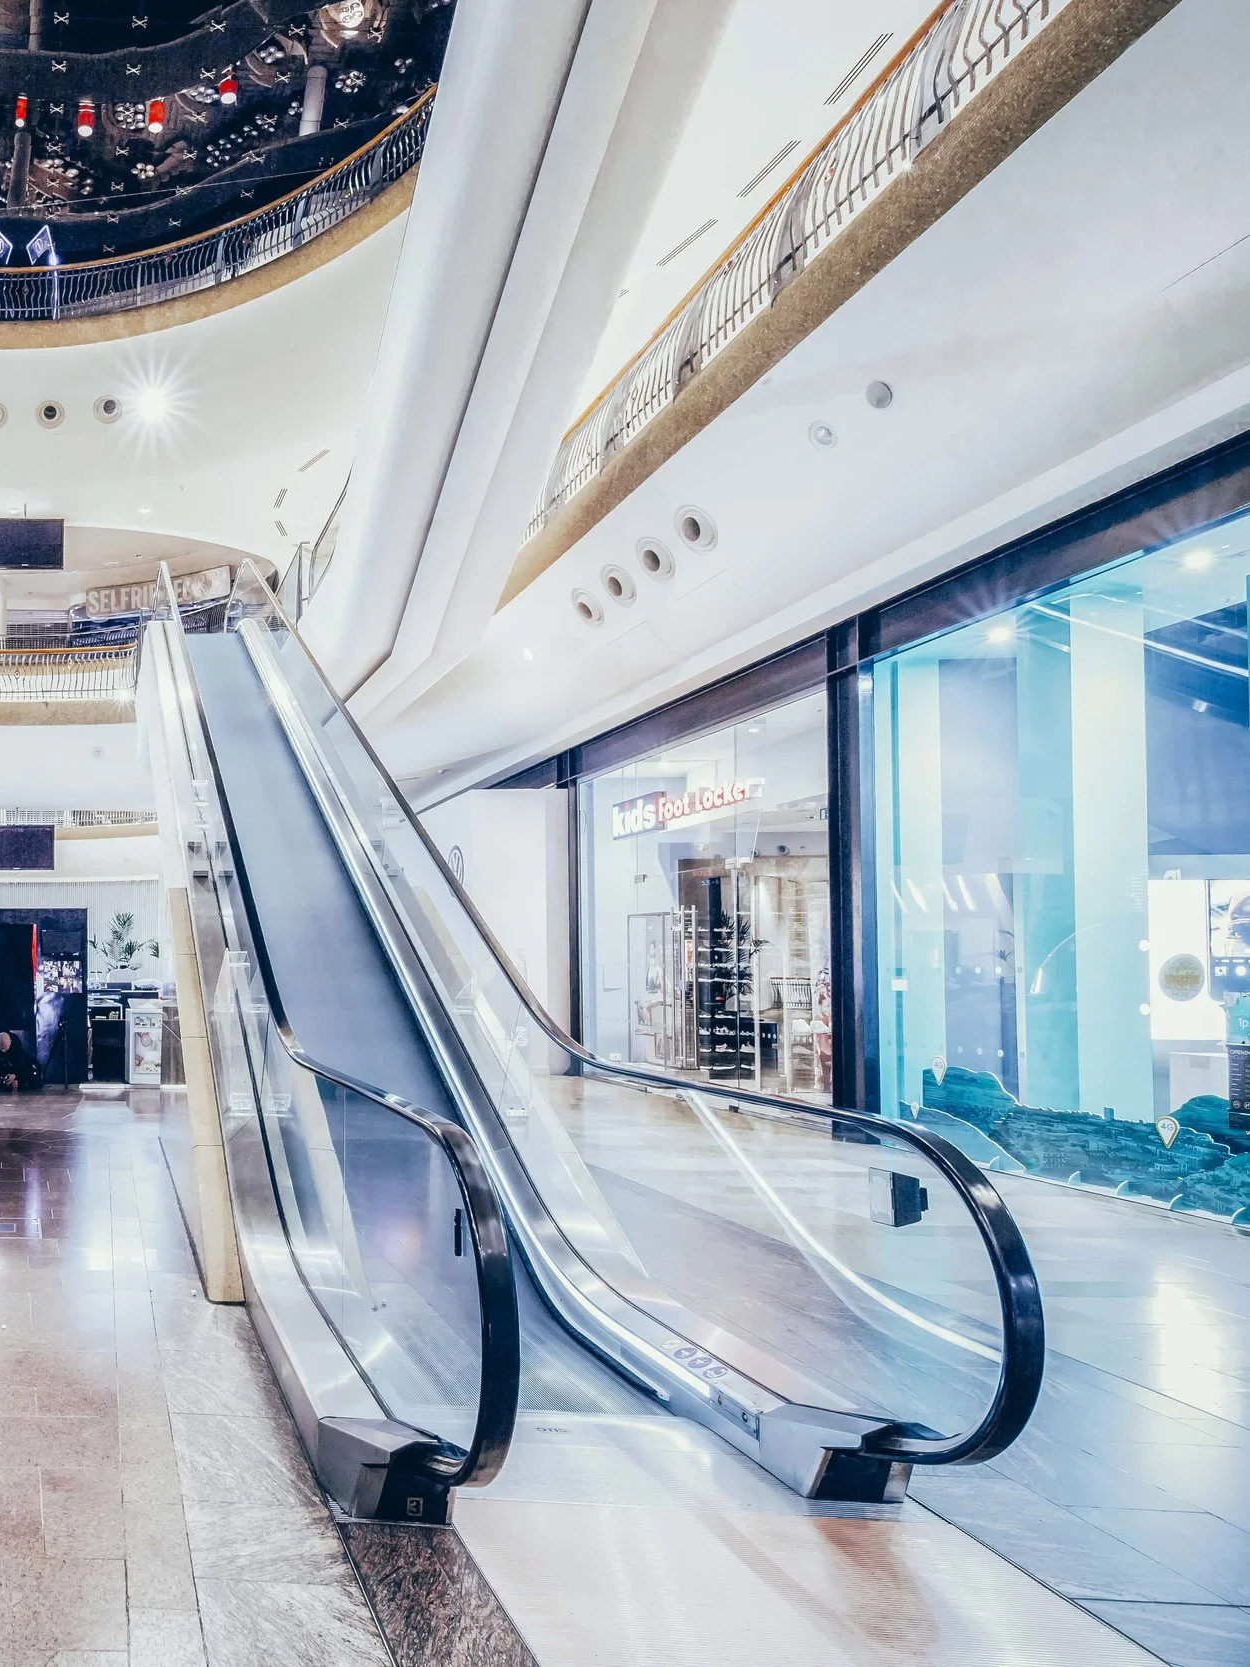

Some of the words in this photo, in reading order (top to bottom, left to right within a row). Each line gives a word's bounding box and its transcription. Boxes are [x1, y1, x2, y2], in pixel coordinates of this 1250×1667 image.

[613, 799, 657, 837] kids
[658, 792, 691, 823] Foot
[694, 782, 751, 812] Locker
[1160, 1123, 1174, 1131] 4G
[409, 1499, 421, 1516] 3
